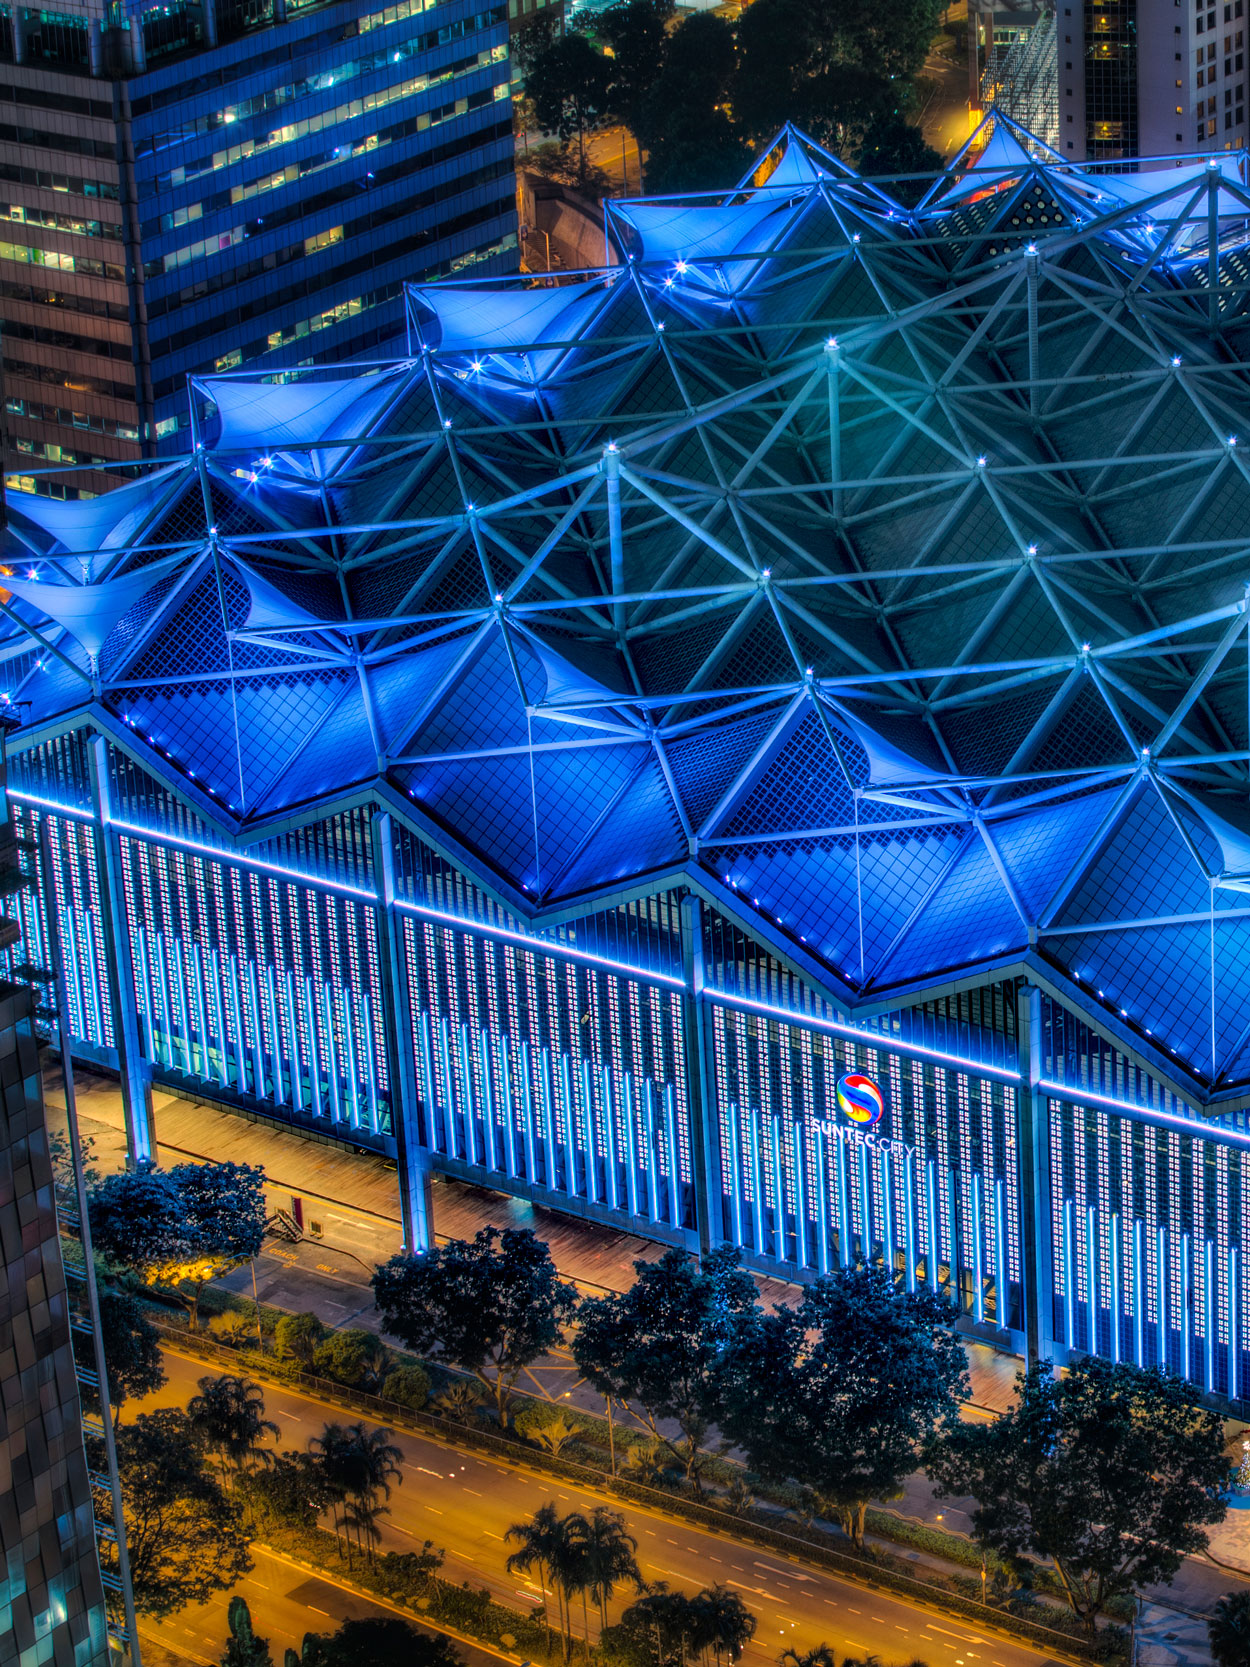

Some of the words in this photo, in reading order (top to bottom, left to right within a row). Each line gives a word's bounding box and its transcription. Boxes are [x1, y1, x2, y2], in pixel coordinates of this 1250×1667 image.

[812, 1118, 876, 1149] SUNTEC
[879, 1138, 916, 1158] CITY
[268, 1248, 299, 1260] COACH
[315, 1263, 340, 1274] ONLY
